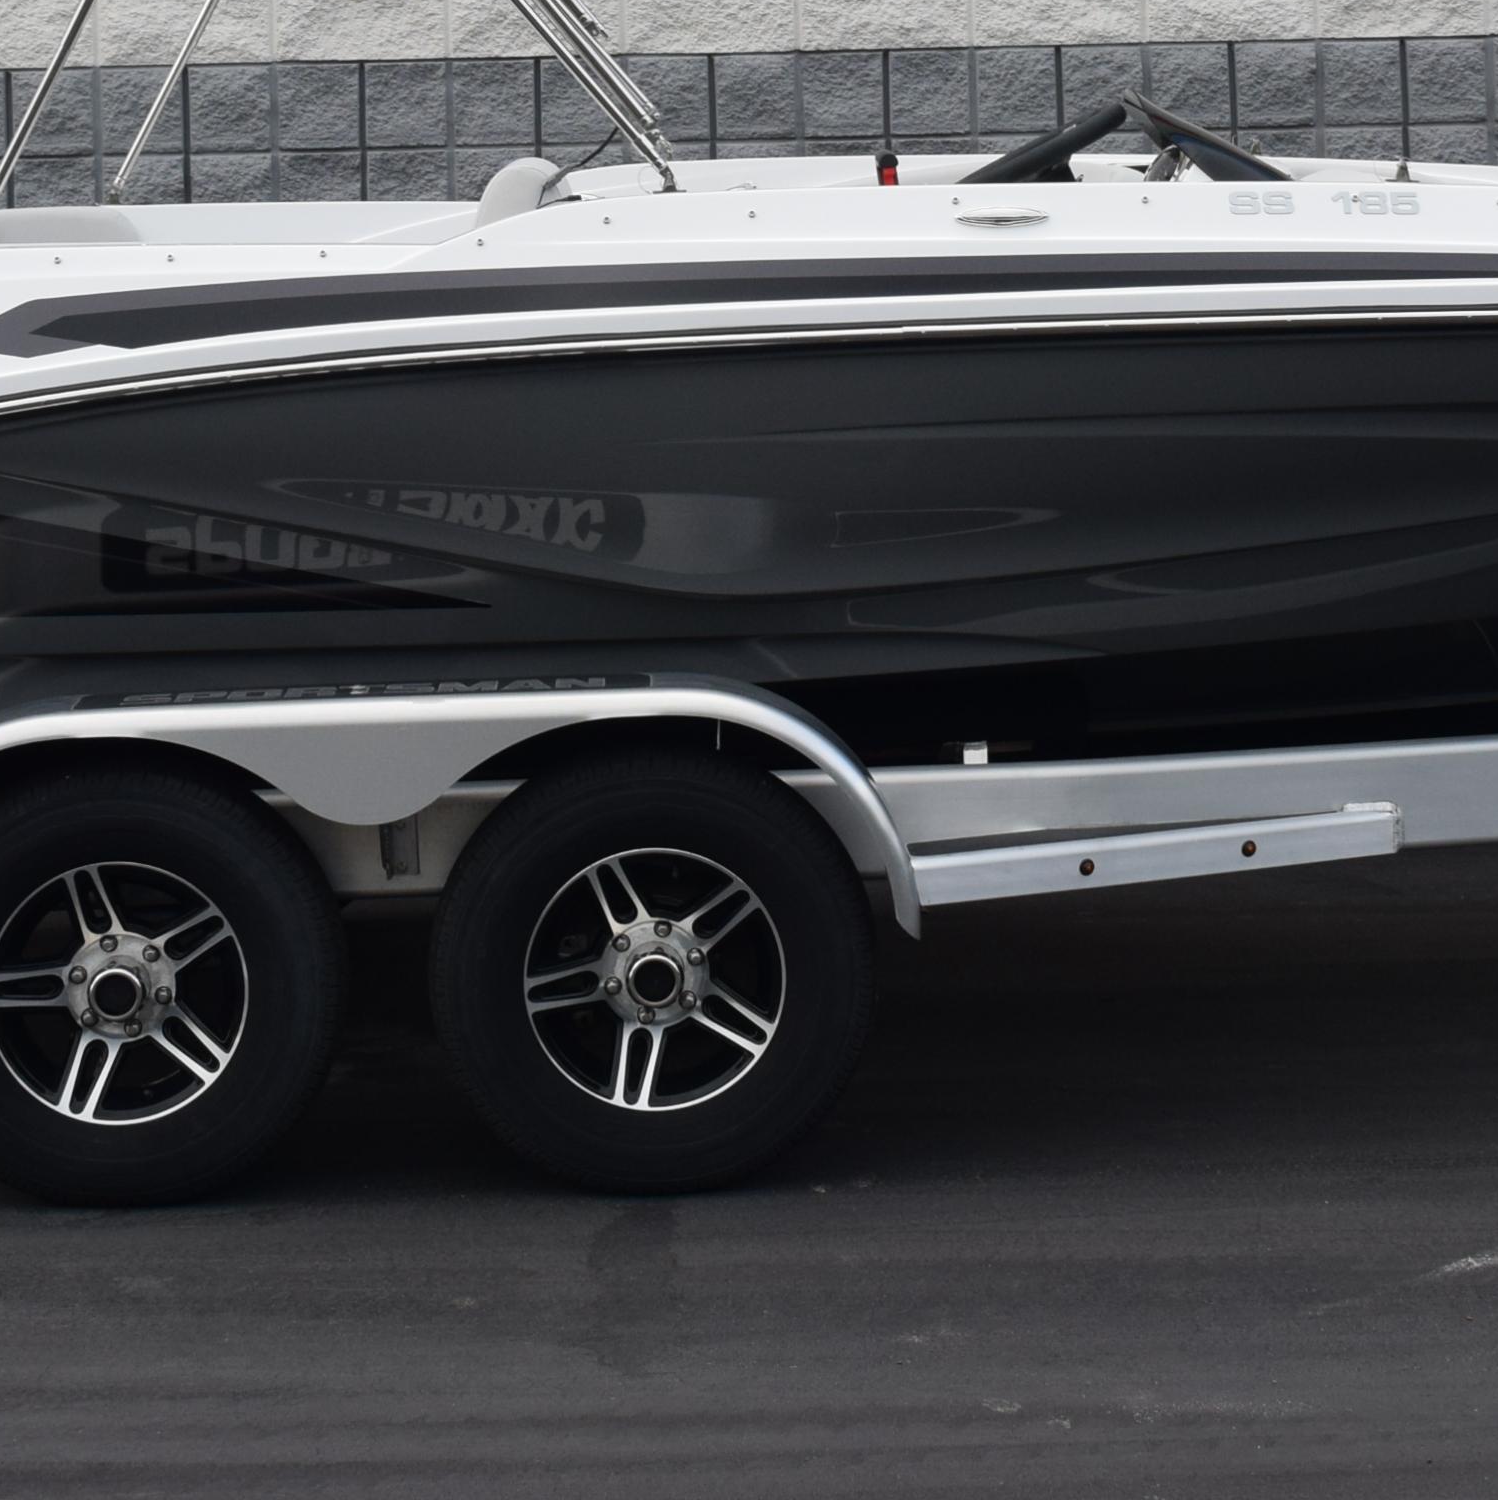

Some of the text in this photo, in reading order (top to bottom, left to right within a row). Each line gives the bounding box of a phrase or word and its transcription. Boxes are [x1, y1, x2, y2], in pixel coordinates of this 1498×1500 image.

[1228, 190, 1421, 216] SS 185
[119, 677, 607, 706] SPORTSMAN
